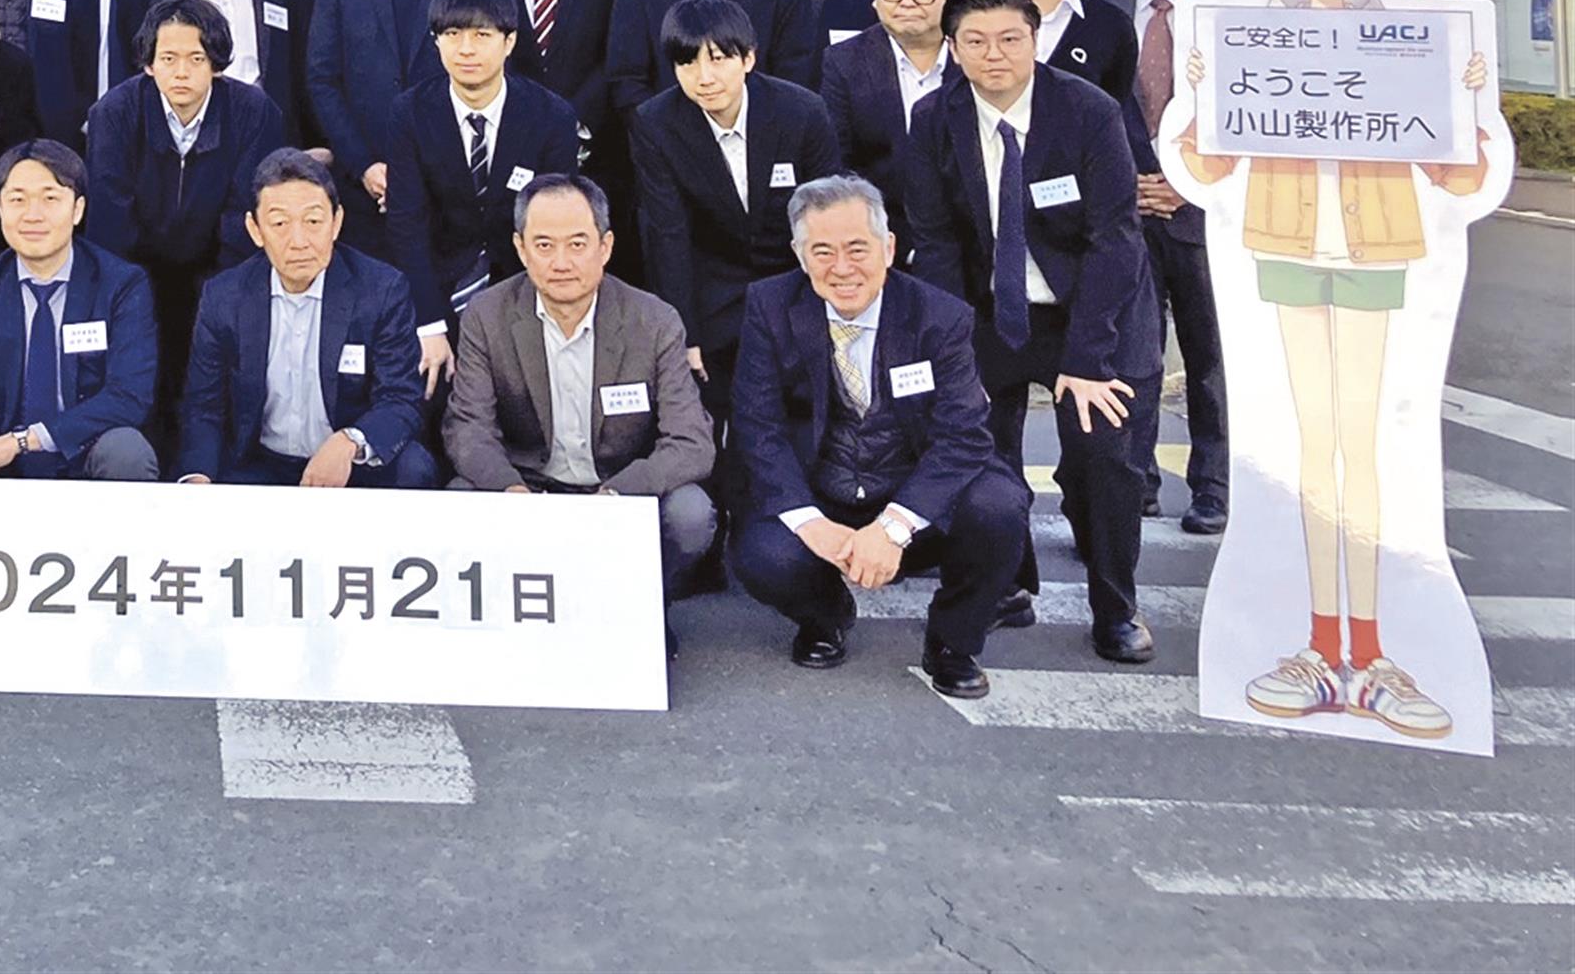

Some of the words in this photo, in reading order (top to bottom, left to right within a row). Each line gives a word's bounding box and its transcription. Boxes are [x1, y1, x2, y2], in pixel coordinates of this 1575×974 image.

[1224, 26, 1337, 49] ご安全に！
[1359, 24, 1429, 43] UACJ
[1229, 67, 1367, 99] ようこそ
[1224, 107, 1437, 142] 小山製作所へ
